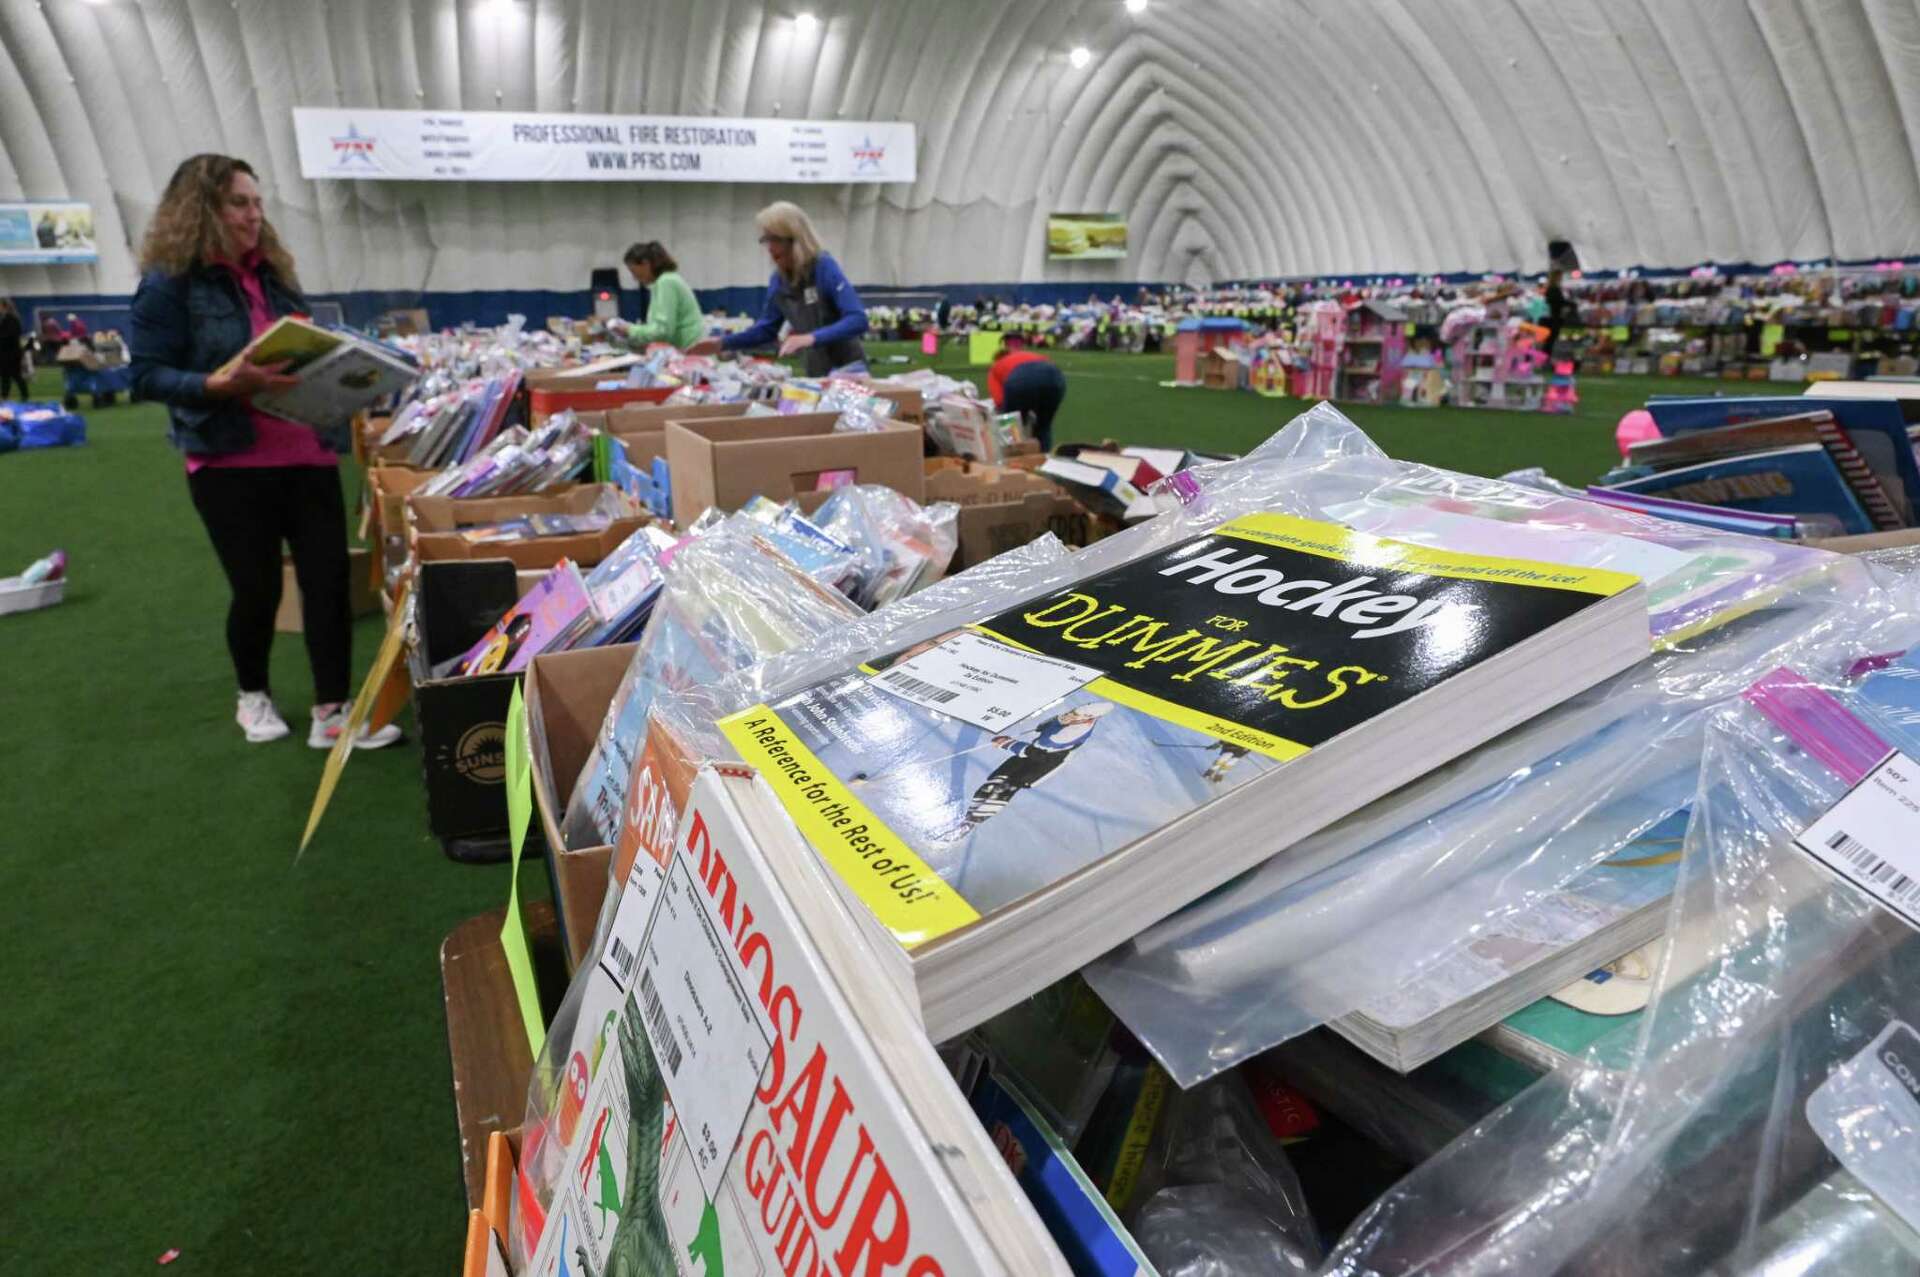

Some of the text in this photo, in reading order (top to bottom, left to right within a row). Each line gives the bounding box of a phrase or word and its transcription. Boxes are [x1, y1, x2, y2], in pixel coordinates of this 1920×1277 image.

[513, 124, 757, 146] PROFESSIONAL FIRE RESTORATION
[586, 151, 701, 171] WWW.PFRS.COM
[1455, 563, 1484, 576] and
[1486, 566, 1514, 580] off
[1513, 570, 1542, 583] the
[1548, 573, 1584, 585] ice!
[1157, 547, 1438, 639] Hockey
[1205, 615, 1249, 632] FOR
[1023, 593, 1382, 709] DUMMIES
[745, 718, 767, 729] A
[1206, 722, 1276, 750] 2nd Edition
[752, 726, 812, 785] Reference
[1885, 767, 1909, 783] 507
[801, 782, 833, 804] for
[1872, 776, 1897, 797] Item
[820, 803, 852, 828] the
[841, 824, 886, 859] Rest
[871, 857, 910, 876] of
[890, 873, 935, 904] Us!
[744, 1129, 830, 1277] GUID
